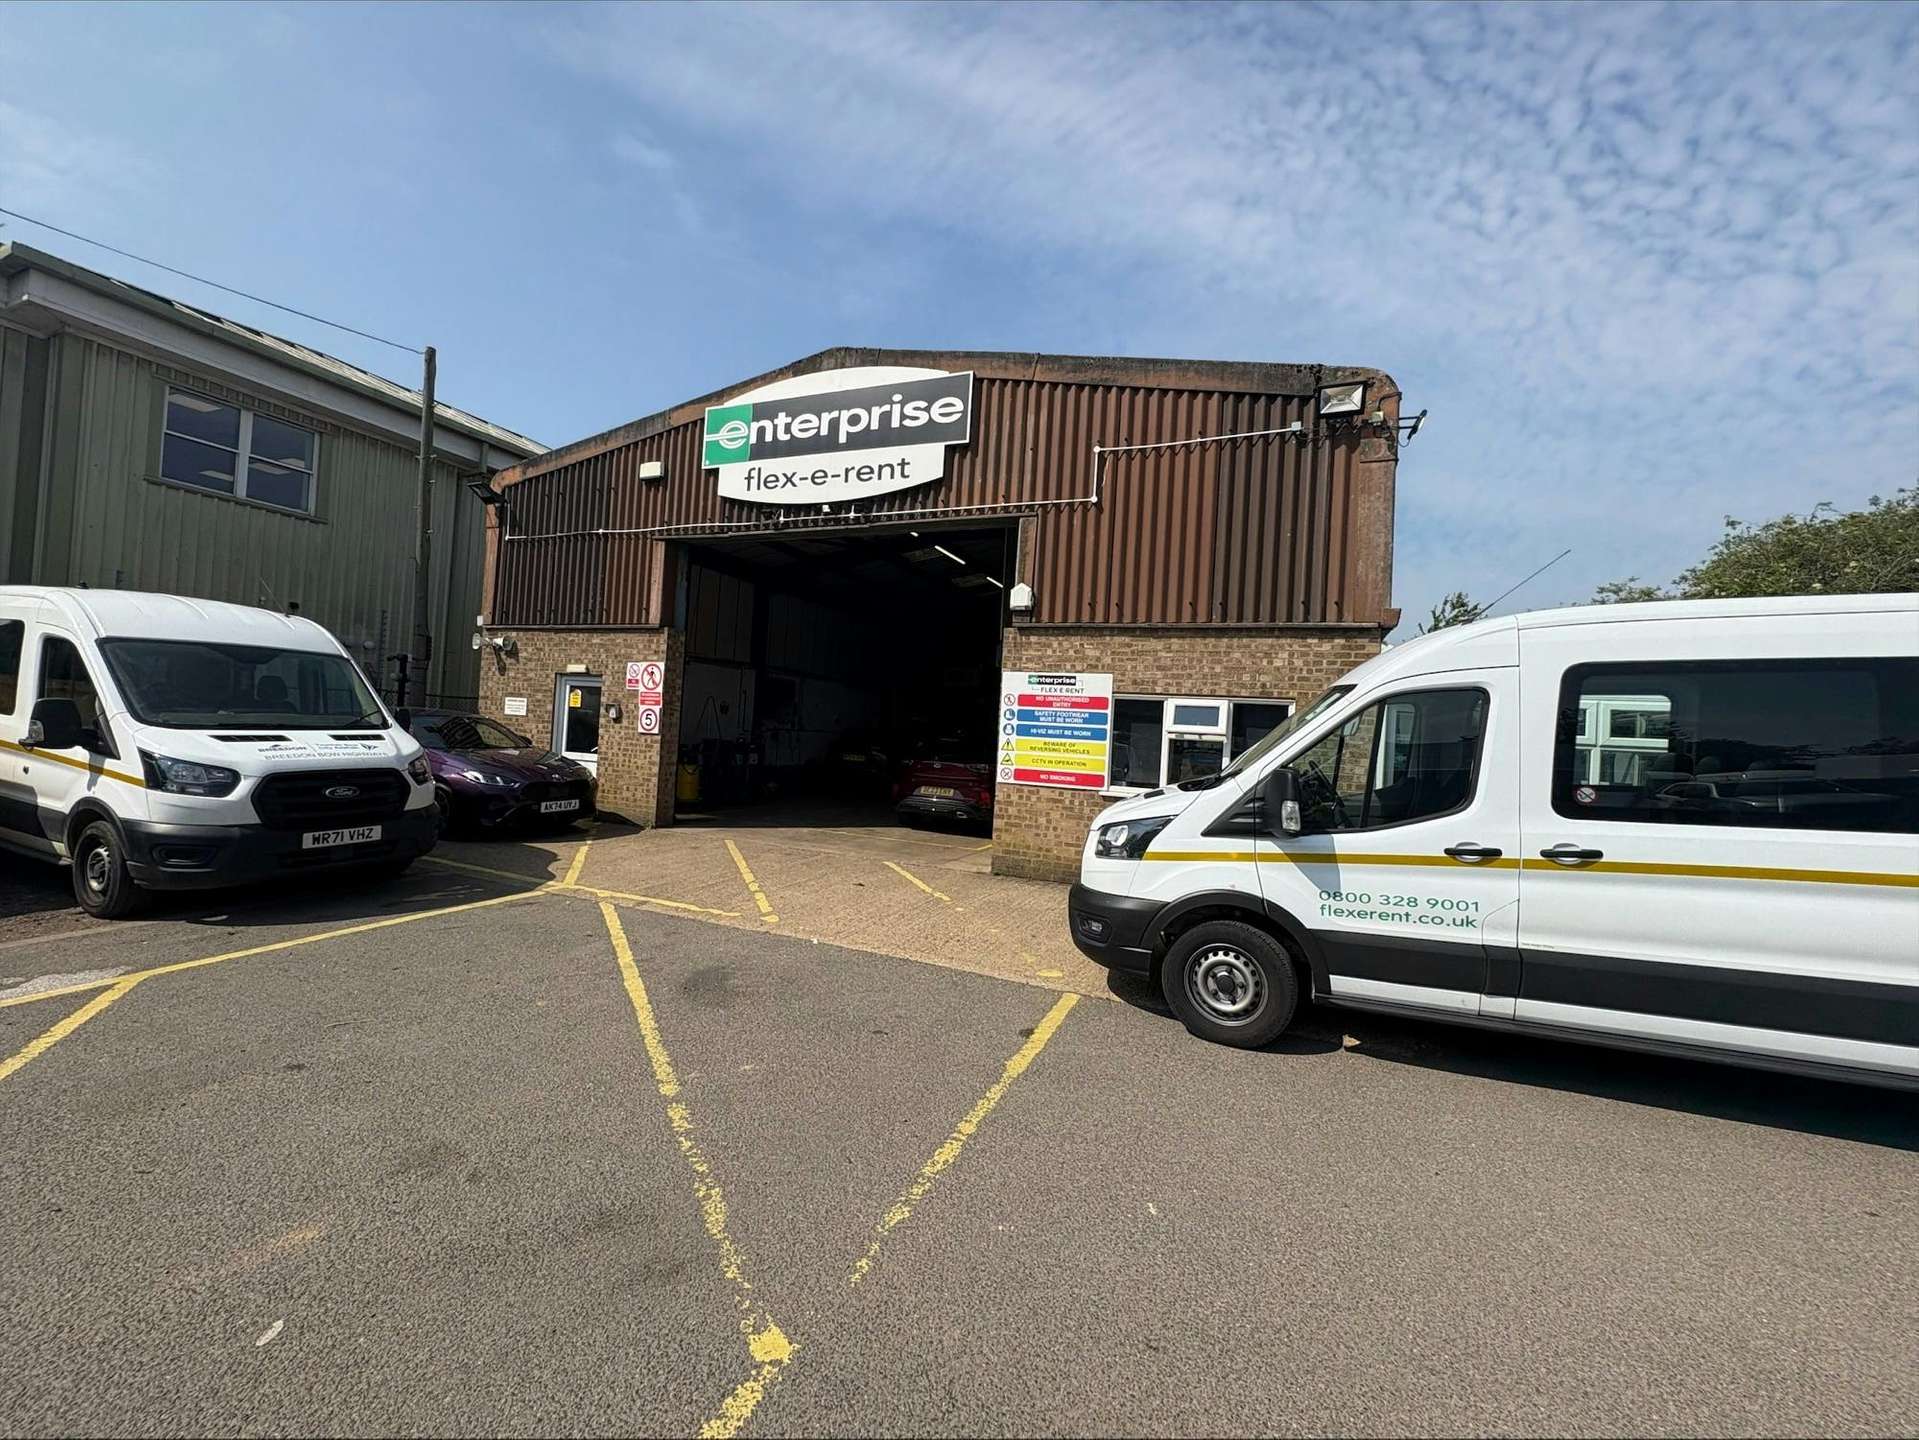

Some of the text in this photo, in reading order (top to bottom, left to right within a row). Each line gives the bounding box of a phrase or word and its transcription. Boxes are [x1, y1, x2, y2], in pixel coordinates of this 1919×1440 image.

[705, 394, 965, 449] enterprise
[744, 458, 911, 491] flex-e-rent
[1030, 676, 1076, 685] enterprise
[644, 713, 653, 727] 5
[1034, 710, 1089, 719] SAFETY FOOTWEAR
[1054, 759, 1087, 767] OPERATION
[311, 827, 374, 846] WR71 VHZ
[1318, 890, 1480, 913] 0800 328 9001
[1319, 903, 1479, 929] flexerent.co.uk
